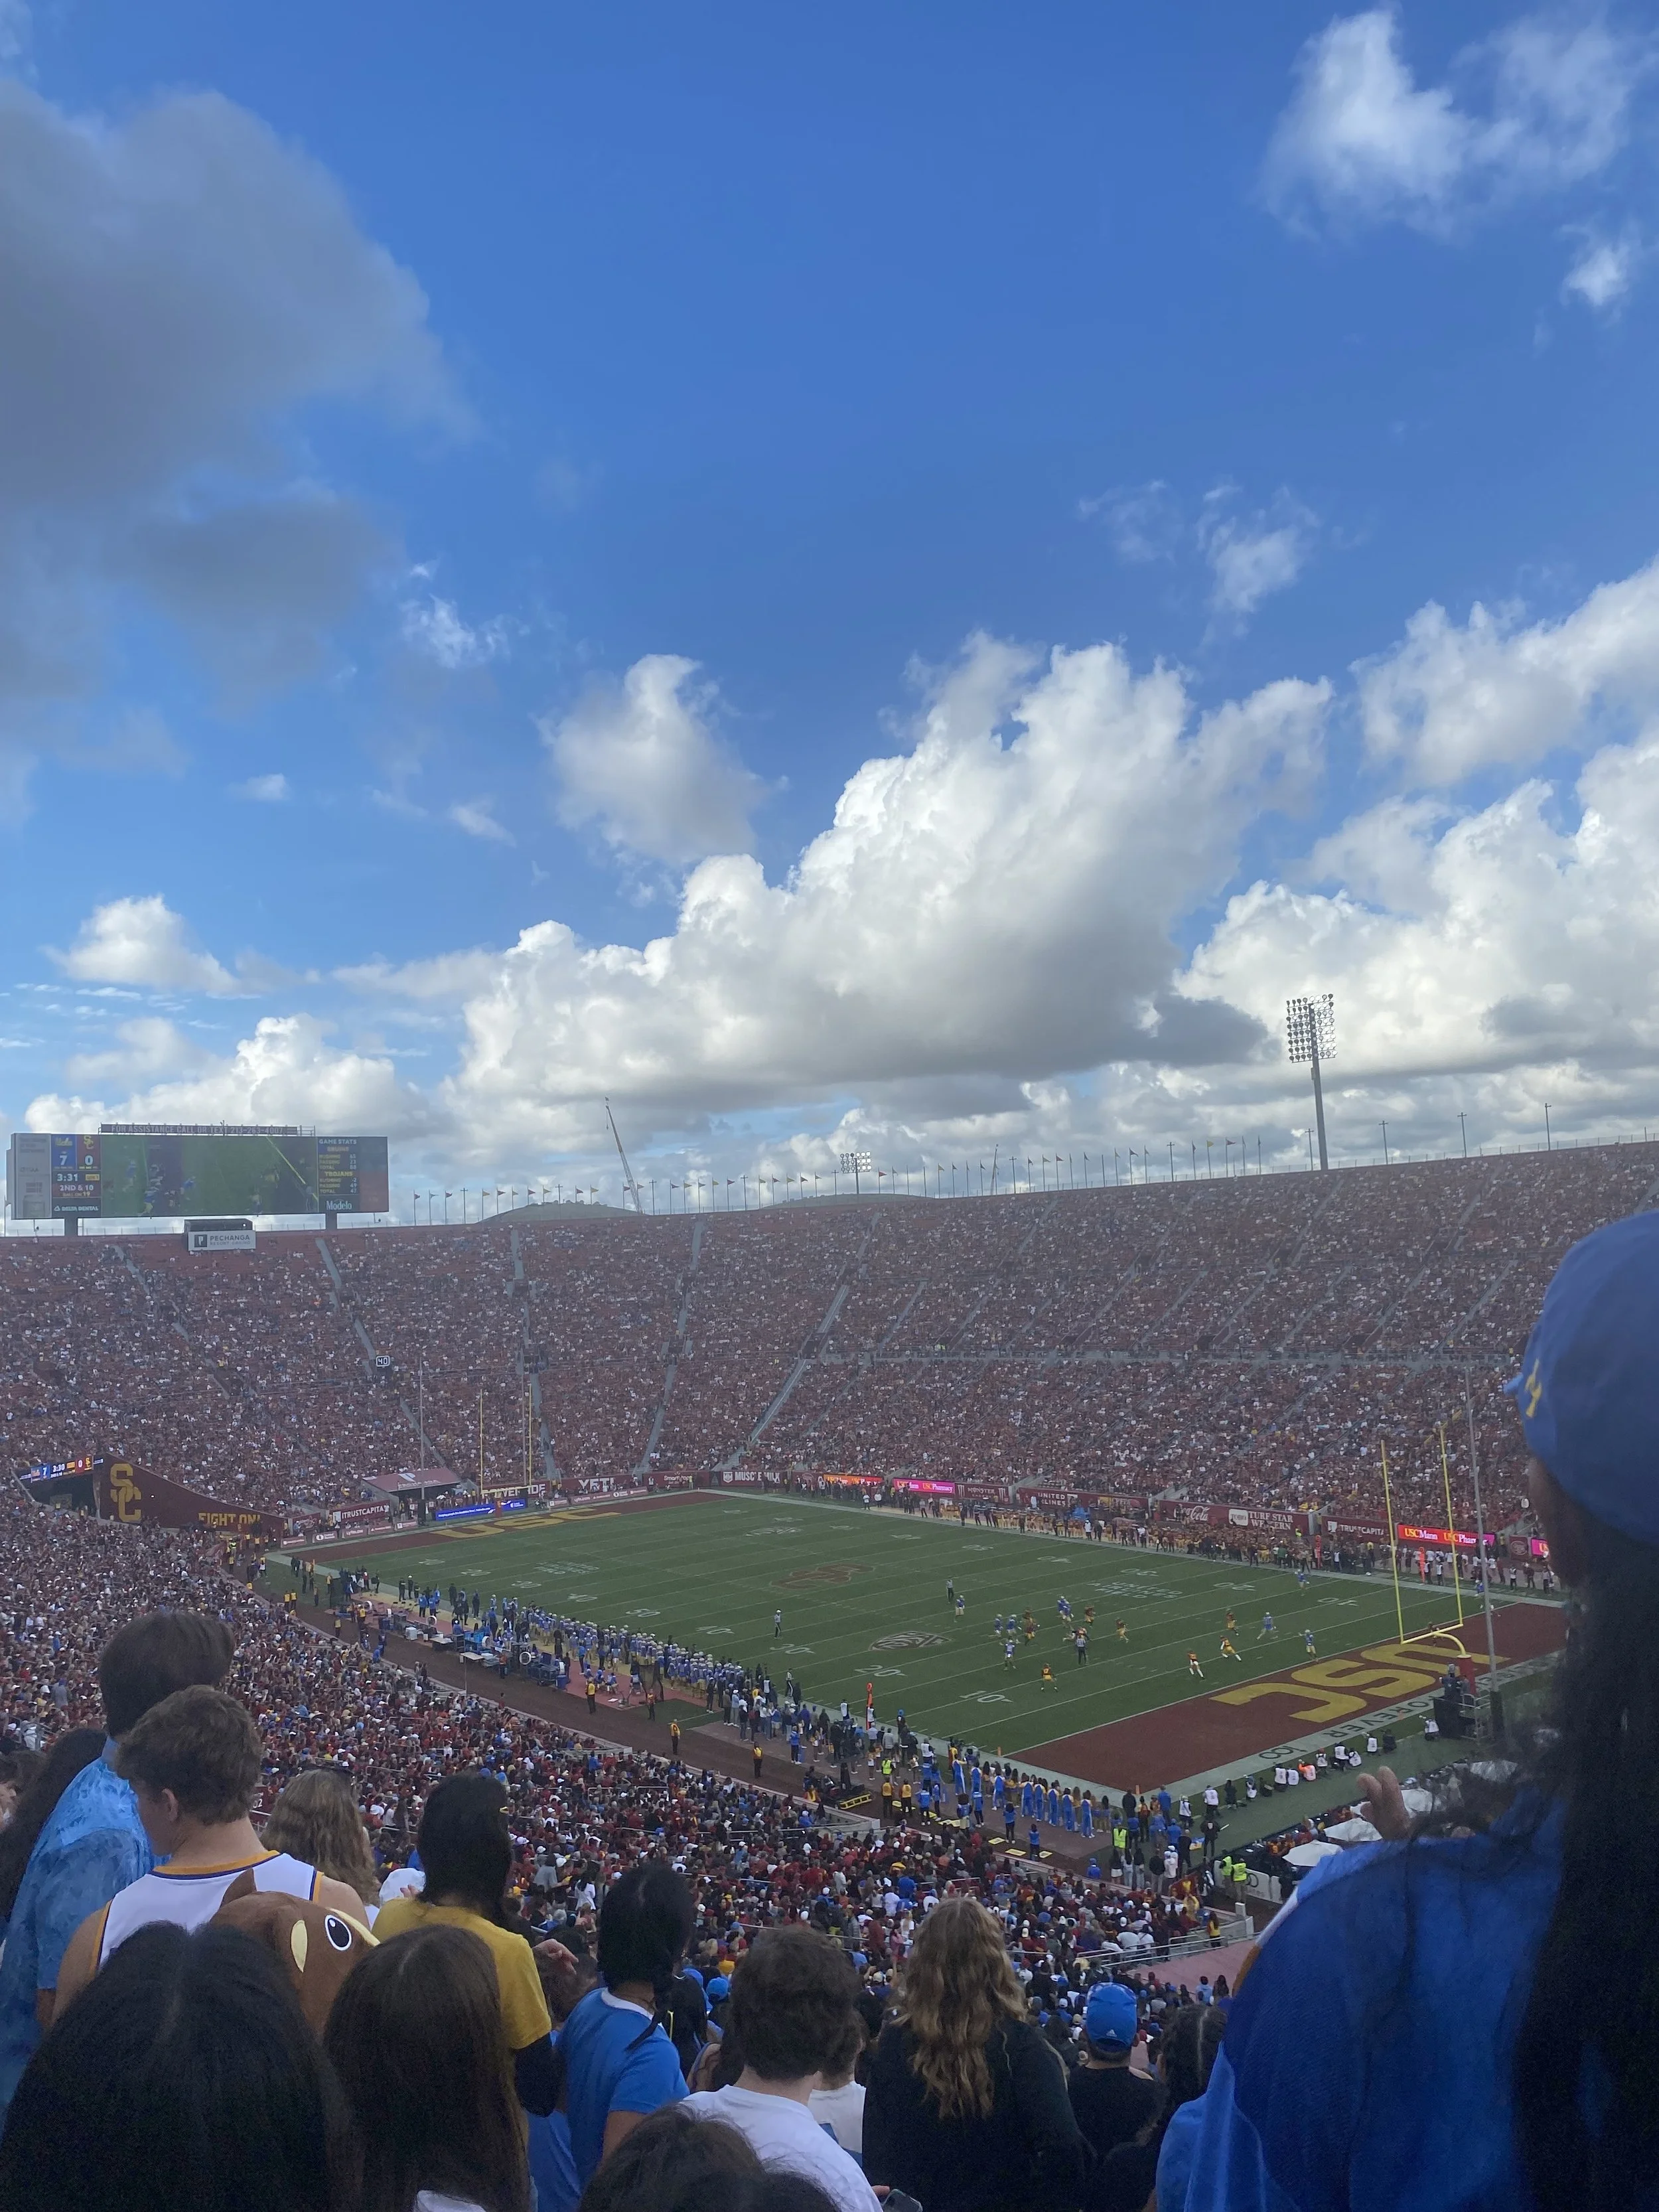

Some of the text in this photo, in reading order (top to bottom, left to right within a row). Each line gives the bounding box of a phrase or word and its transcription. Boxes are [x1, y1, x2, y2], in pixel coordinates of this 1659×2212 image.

[60, 1155, 67, 1165] 7
[85, 1155, 93, 1165] 0
[326, 1201, 352, 1210] Modelo
[42, 1467, 47, 1475] 7
[53, 1463, 65, 1473] 3:30
[735, 1471, 762, 1481] MUSCE
[579, 1477, 614, 1491] YETI
[110, 1463, 142, 1522] SC
[342, 1505, 388, 1519] ITRUSTCAPITA
[1248, 1511, 1294, 1523] TURF STAR
[199, 1512, 261, 1526] FIGHT ON!
[431, 1508, 622, 1539] USC
[770, 1643, 807, 1656] 30
[855, 1664, 901, 1678] 20
[1209, 1644, 1511, 1724] USC
[960, 1689, 1005, 1704] 10
